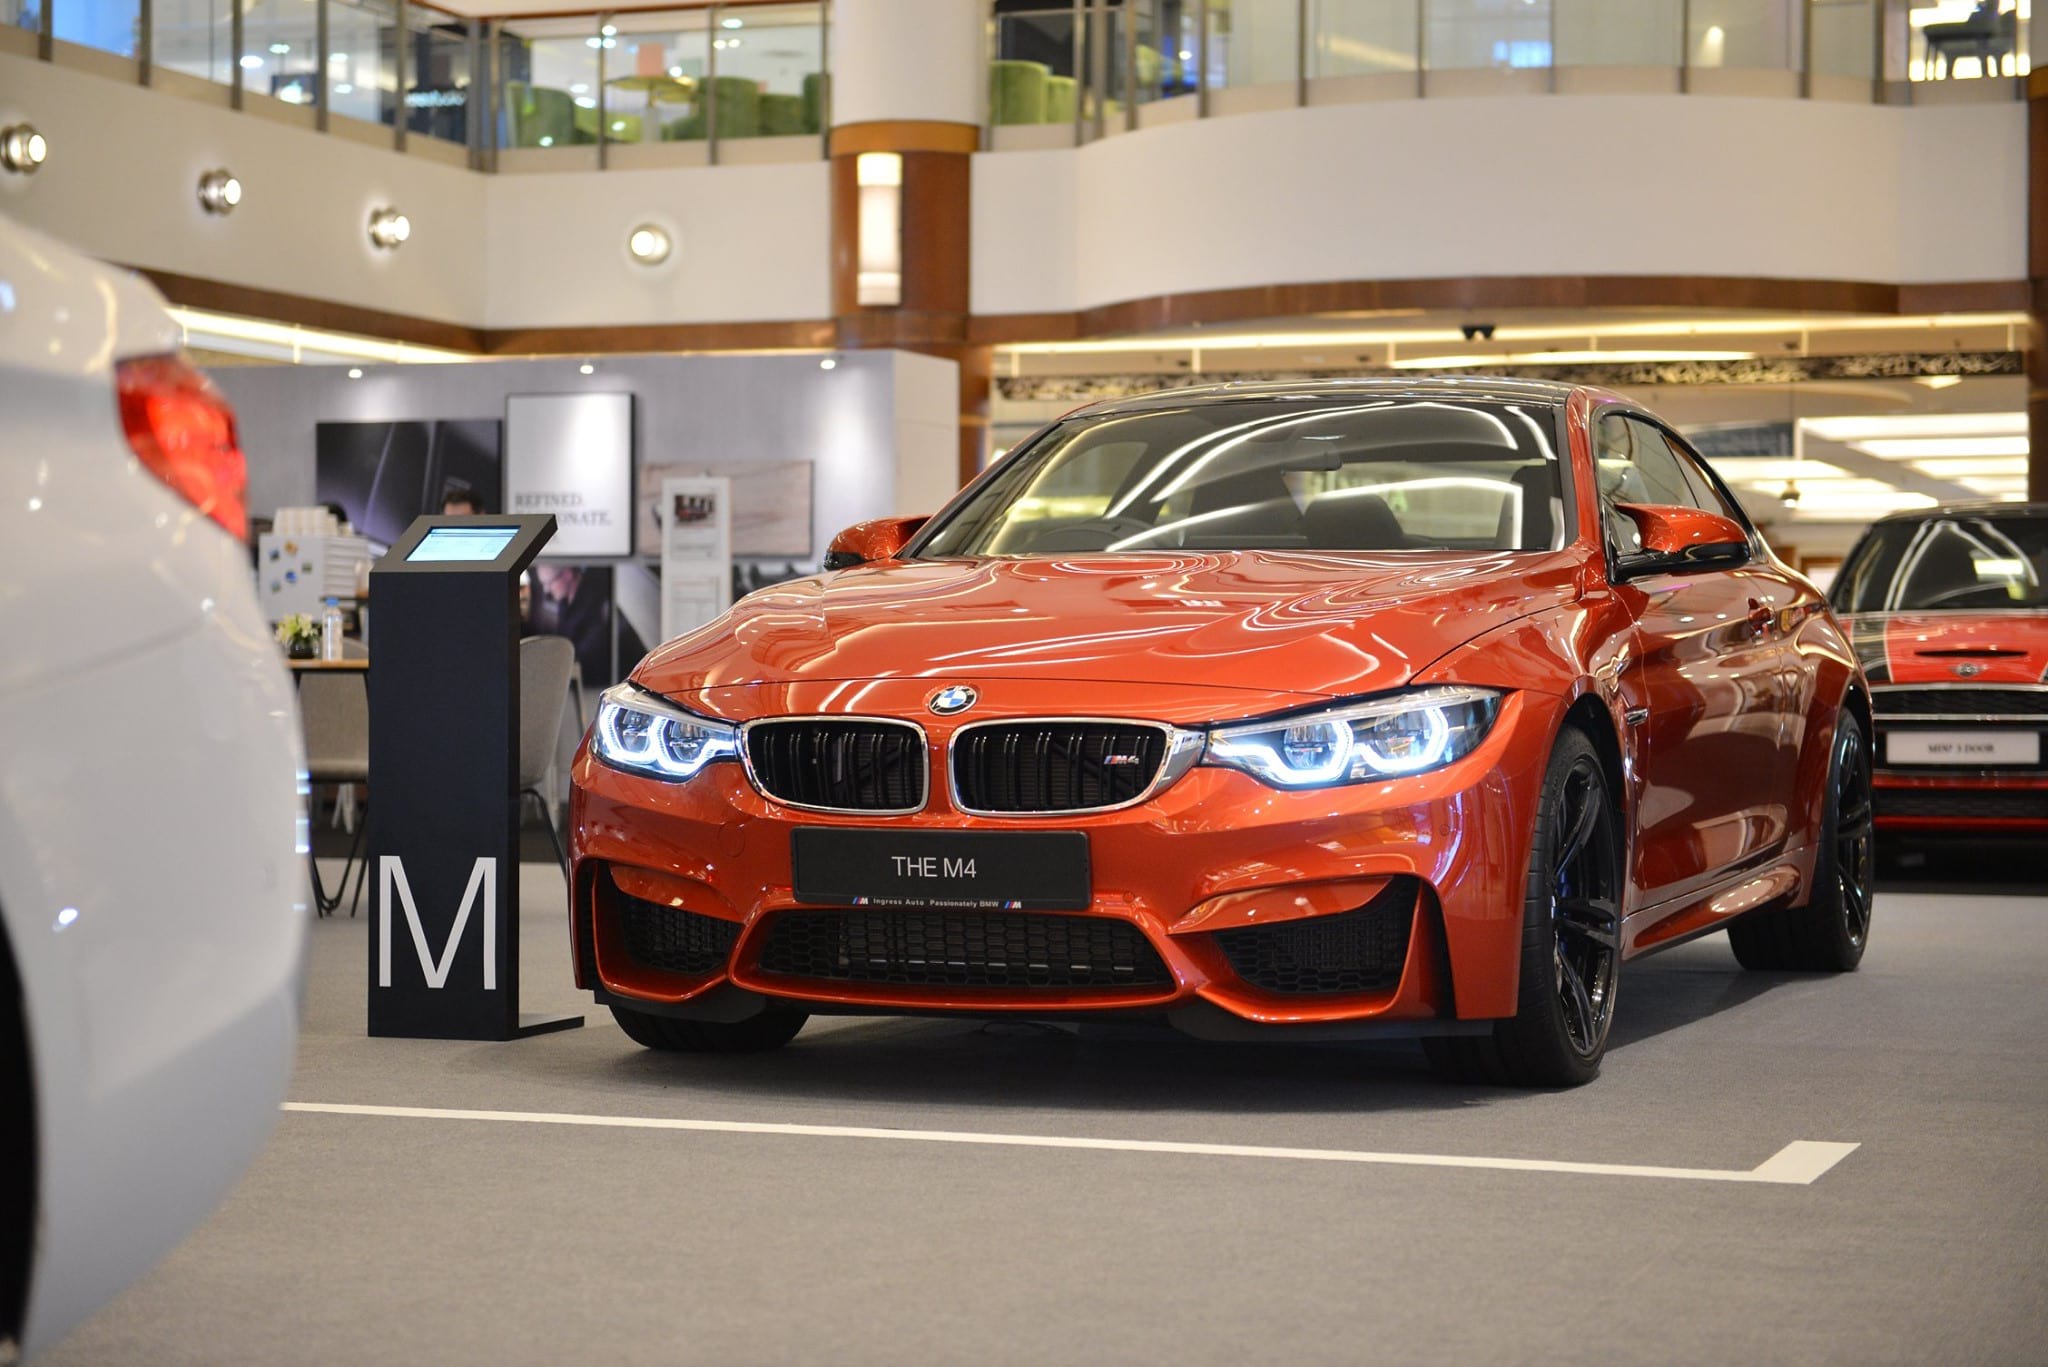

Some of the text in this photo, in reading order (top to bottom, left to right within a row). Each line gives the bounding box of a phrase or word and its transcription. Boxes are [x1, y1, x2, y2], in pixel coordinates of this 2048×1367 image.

[891, 856, 976, 878] THE M4
[873, 897, 903, 906] Ingress
[905, 898, 925, 906] Auto
[929, 898, 978, 909] Passionately
[979, 900, 999, 908] BMW
[379, 855, 496, 990] M
